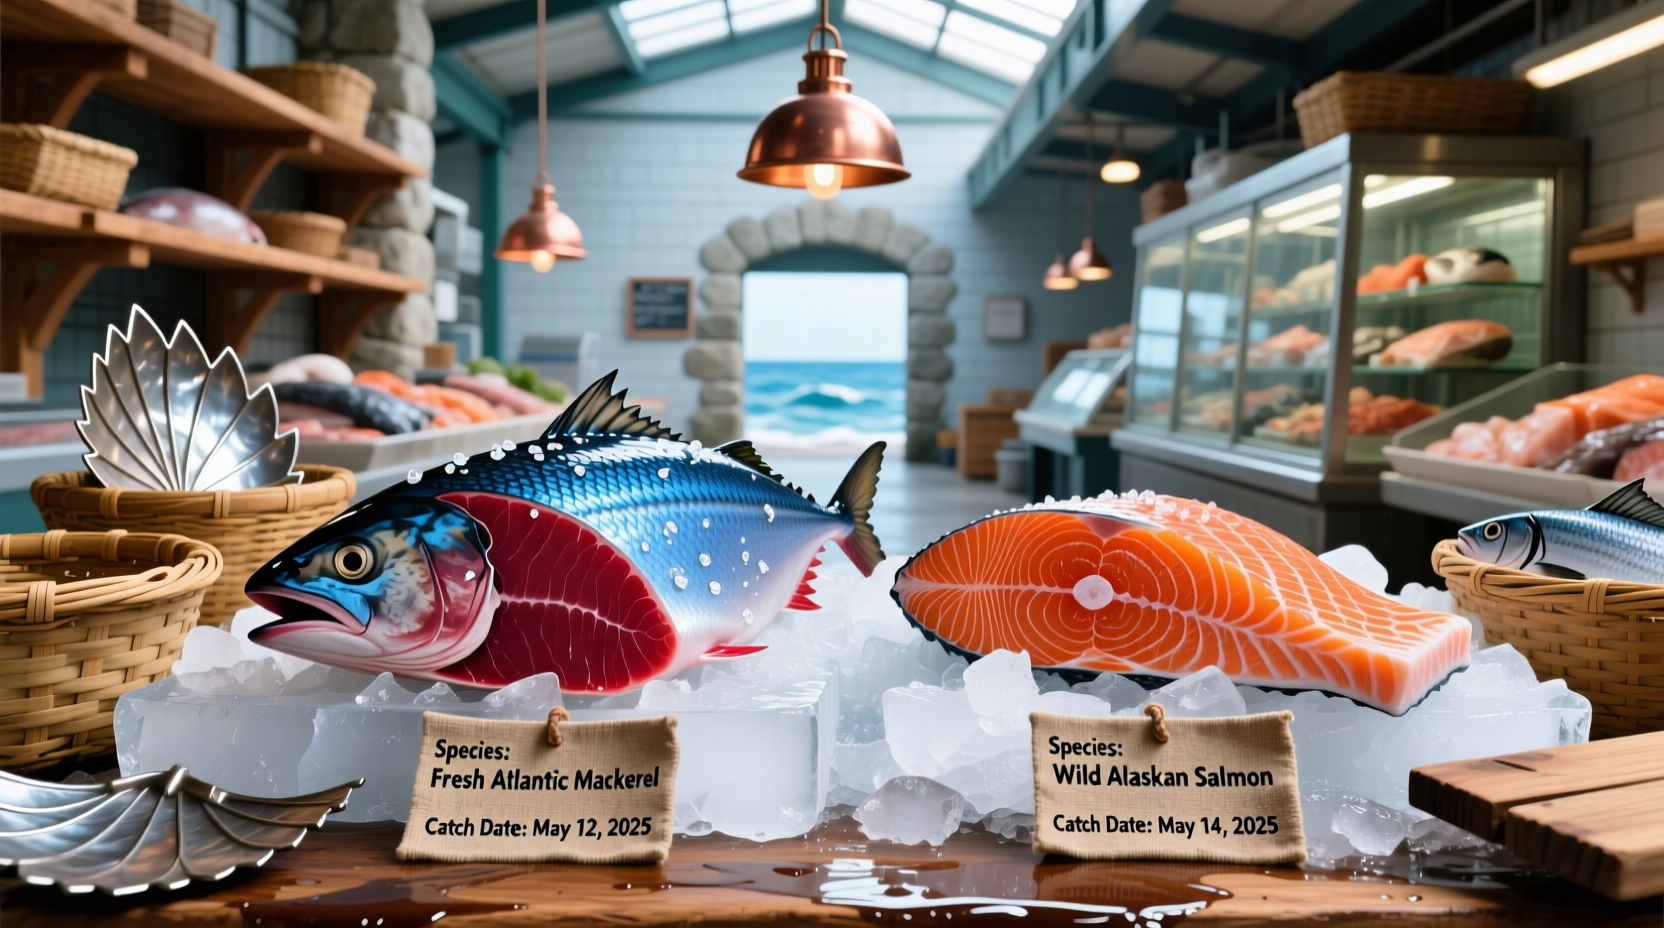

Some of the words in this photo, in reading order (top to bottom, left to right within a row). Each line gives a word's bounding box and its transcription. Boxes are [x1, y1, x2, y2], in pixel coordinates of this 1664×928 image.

[434, 738, 511, 765] Species:
[1048, 735, 1123, 760] Species:
[430, 767, 485, 790] Fresh
[490, 768, 569, 791] Atlantic
[573, 765, 660, 791] Mackerel
[1052, 763, 1102, 786] Wild
[1106, 764, 1189, 787] Alaskan
[1194, 765, 1274, 788] Salmon
[424, 817, 475, 837] Catch
[479, 818, 527, 837] Date:
[532, 818, 572, 842] May
[576, 817, 602, 841] 12,
[607, 816, 653, 837] 2025
[1053, 814, 1101, 833] Catch
[1105, 815, 1153, 833] Date:
[1158, 815, 1196, 840] May
[1200, 816, 1228, 839] 14,
[1232, 815, 1279, 835] 2025
